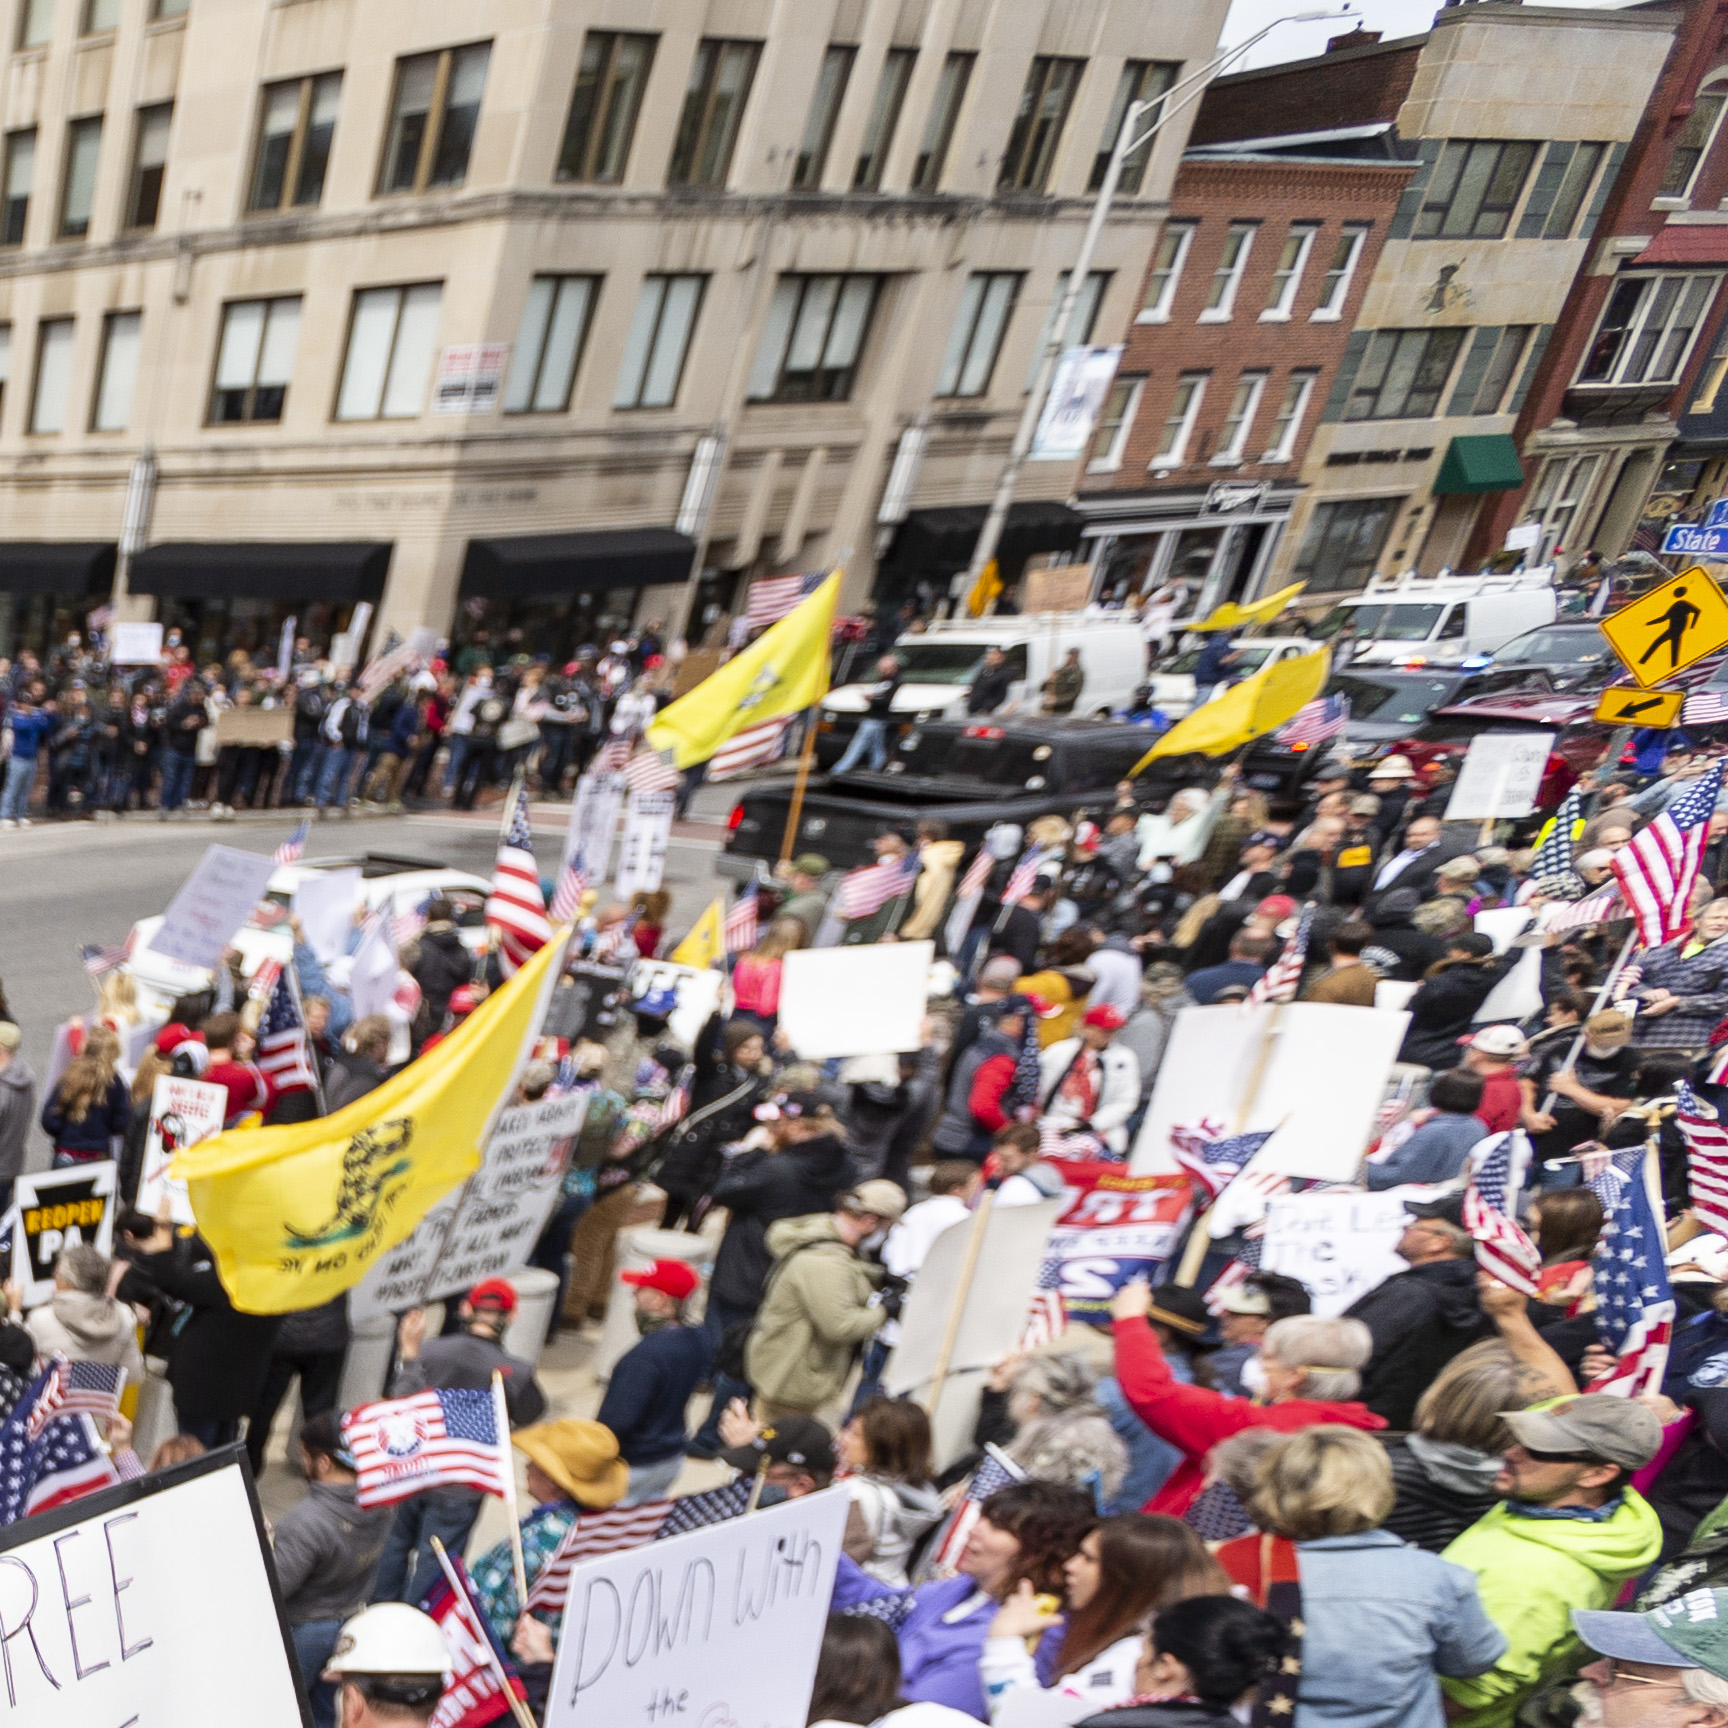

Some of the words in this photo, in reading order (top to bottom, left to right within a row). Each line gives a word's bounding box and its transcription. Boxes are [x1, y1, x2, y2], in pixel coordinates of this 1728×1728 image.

[1673, 528, 1721, 551] State
[23, 1197, 105, 1235] REOPEN
[38, 1225, 84, 1265] PA
[645, 1687, 689, 1722] the
